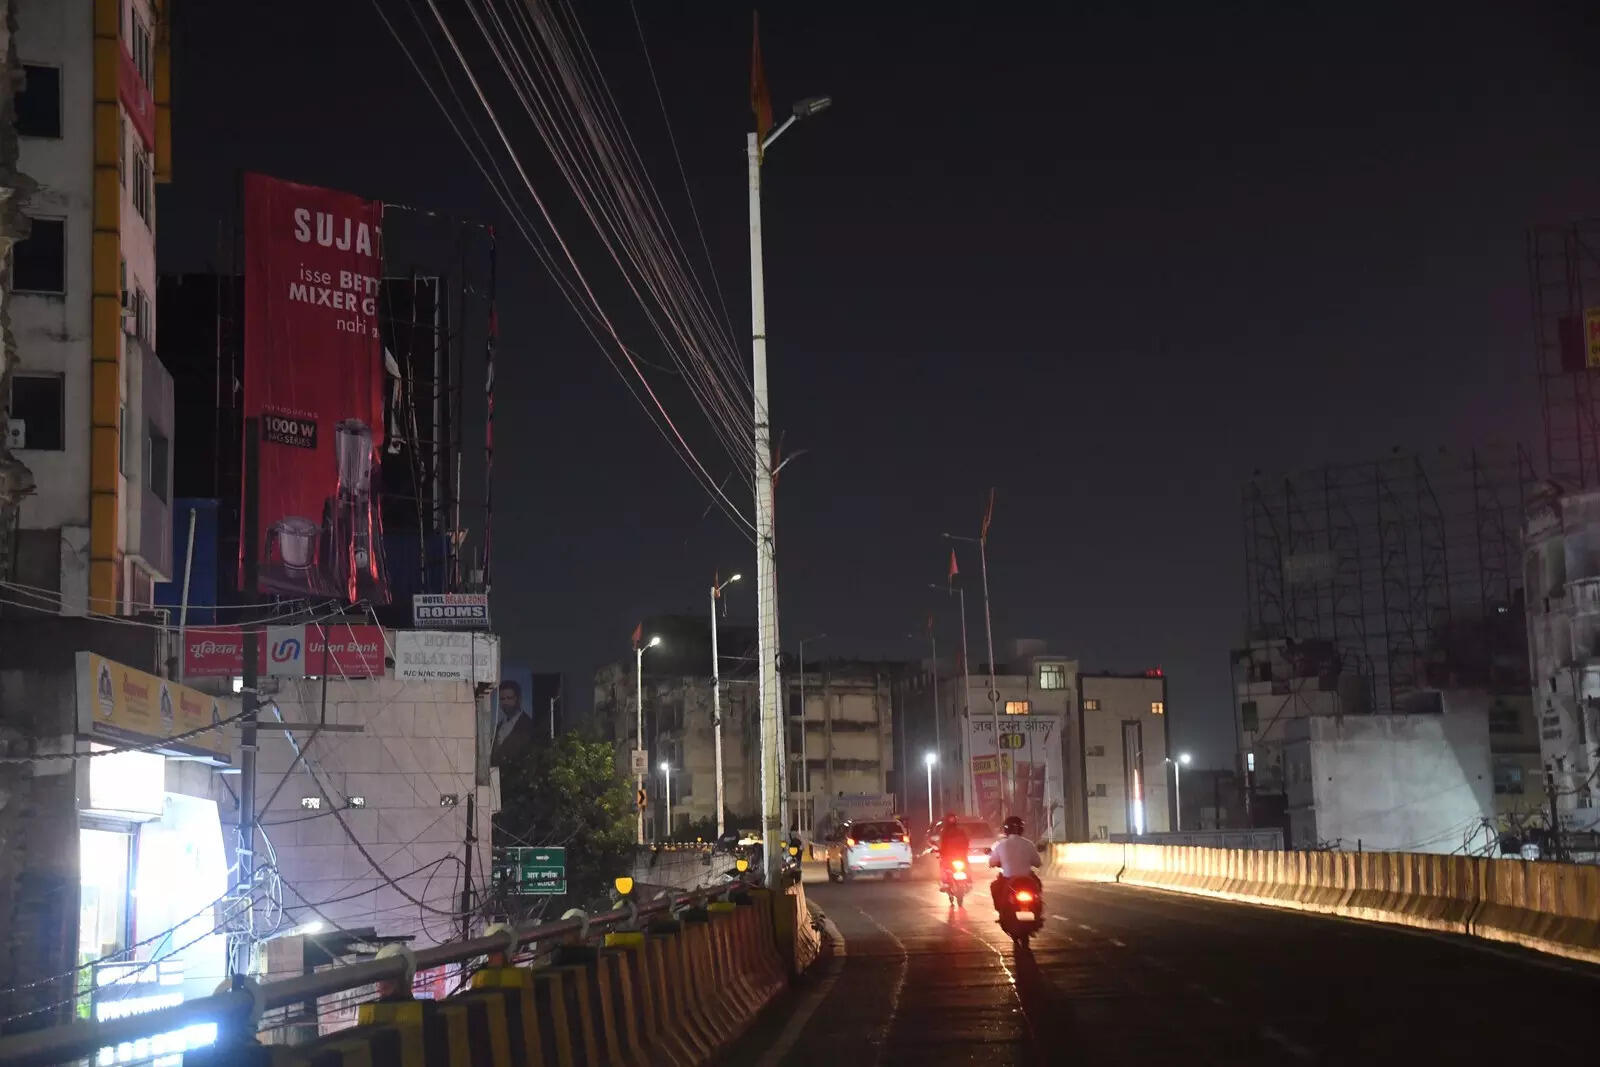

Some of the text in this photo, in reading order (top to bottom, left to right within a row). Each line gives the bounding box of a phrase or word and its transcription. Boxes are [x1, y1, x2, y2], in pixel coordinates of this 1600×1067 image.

[300, 263, 332, 285] isse
[289, 282, 357, 313] MIXER
[336, 315, 366, 334] nahi
[265, 416, 314, 438] 1000 W
[422, 596, 444, 604] HOTEL
[419, 606, 484, 617] ROOMS
[190, 640, 236, 657] यूनियन
[309, 641, 378, 653] Unon Bank
